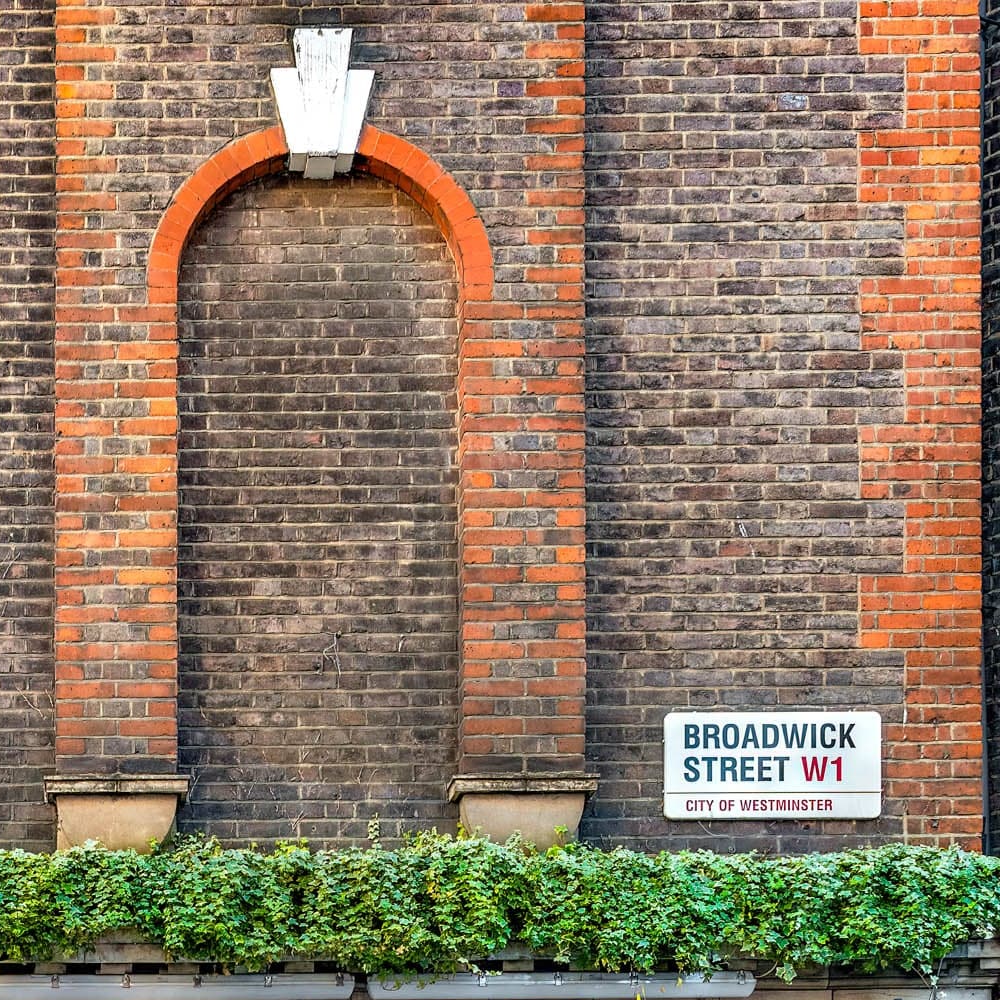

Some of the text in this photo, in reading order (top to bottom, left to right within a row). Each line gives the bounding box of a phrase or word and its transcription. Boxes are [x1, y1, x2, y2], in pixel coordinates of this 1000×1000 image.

[683, 723, 856, 749] BROADWICK
[683, 756, 843, 782] STREET W1
[685, 799, 833, 812] CITY OF WESTMINSTER
